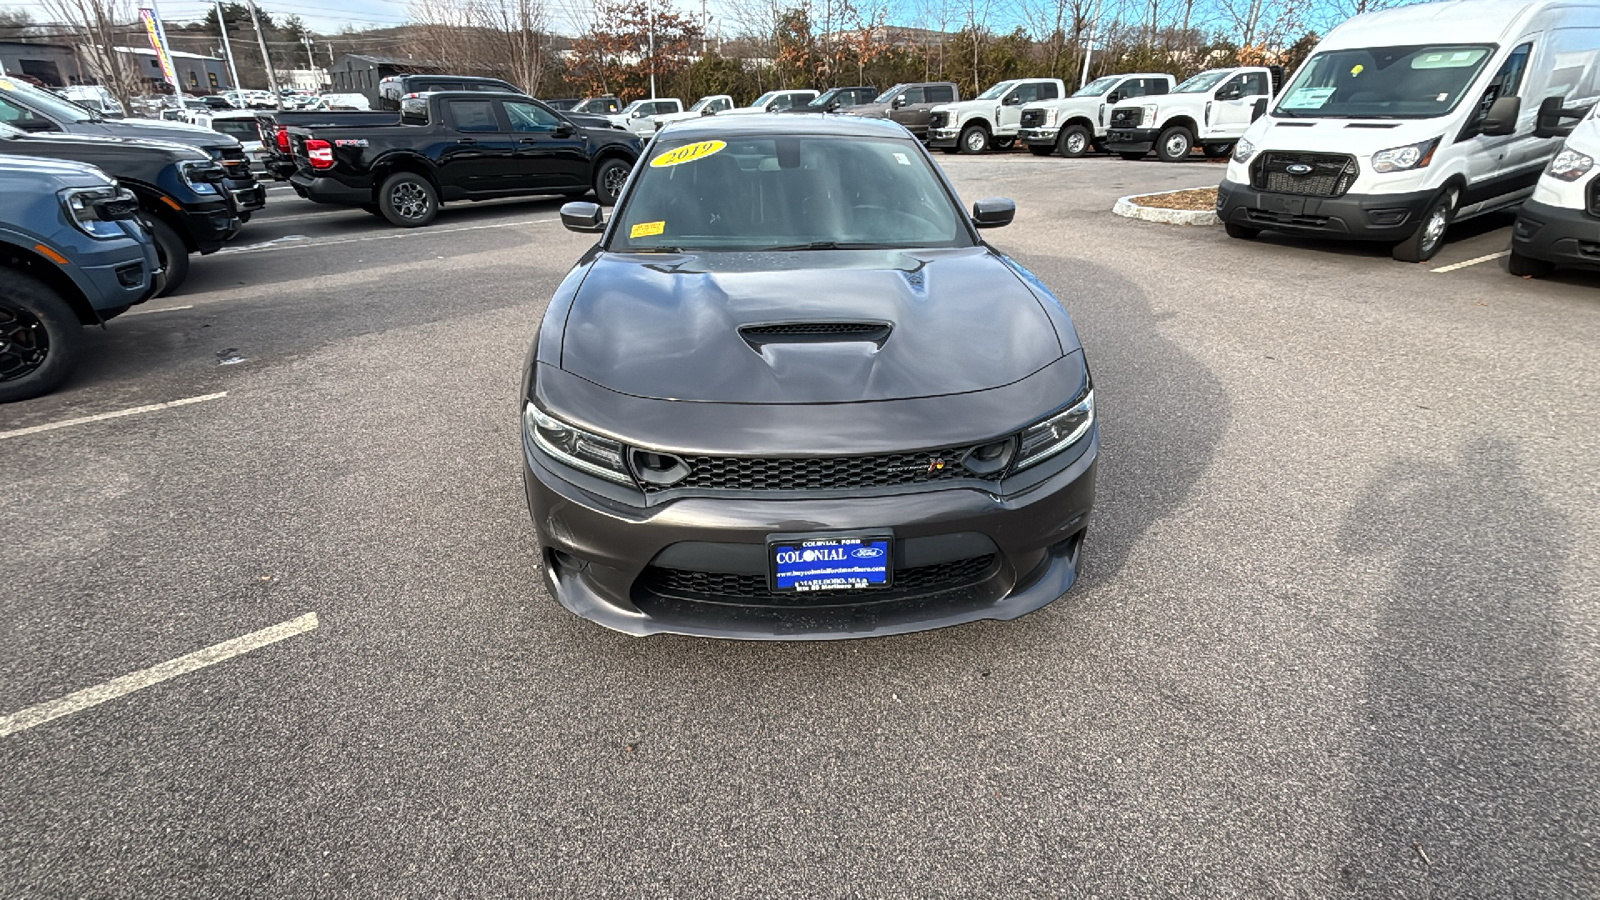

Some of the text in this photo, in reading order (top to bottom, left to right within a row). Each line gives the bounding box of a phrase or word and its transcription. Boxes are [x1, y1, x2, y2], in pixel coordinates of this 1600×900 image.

[335, 139, 369, 147] FX4
[665, 142, 713, 164] 2019
[776, 548, 847, 564] COLONIAL
